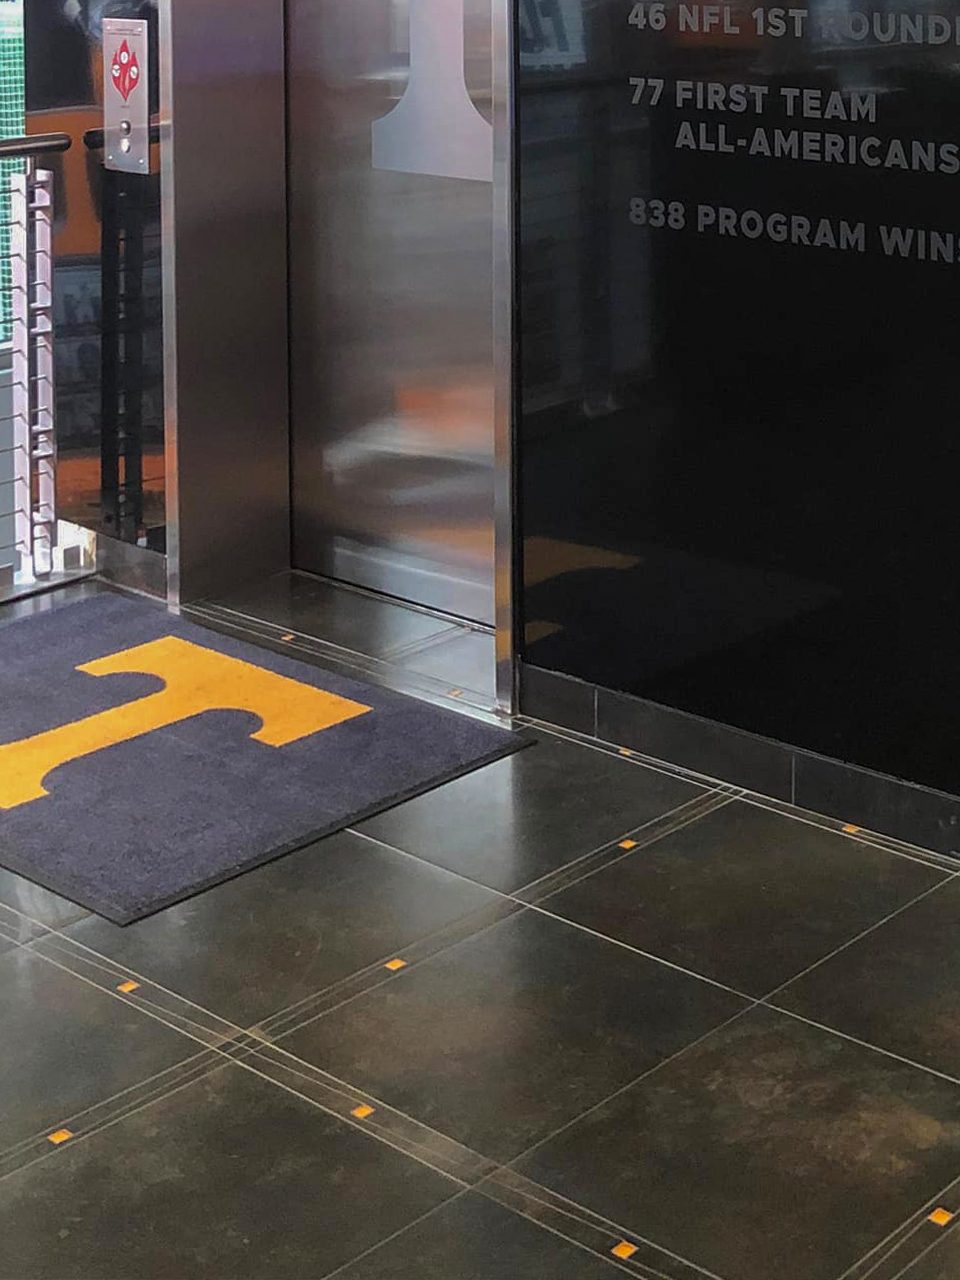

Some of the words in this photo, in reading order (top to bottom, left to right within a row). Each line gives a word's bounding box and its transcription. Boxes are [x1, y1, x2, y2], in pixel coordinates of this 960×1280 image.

[628, 4, 667, 31] 46
[679, 5, 740, 34] NFL
[752, 7, 808, 38] 1ST
[628, 77, 665, 106] 77
[675, 79, 770, 115] FIRST
[780, 86, 878, 123] TEAM
[675, 121, 960, 175] ALL-AMERICANS
[628, 197, 686, 230] 838
[697, 203, 866, 252] PROGRAM
